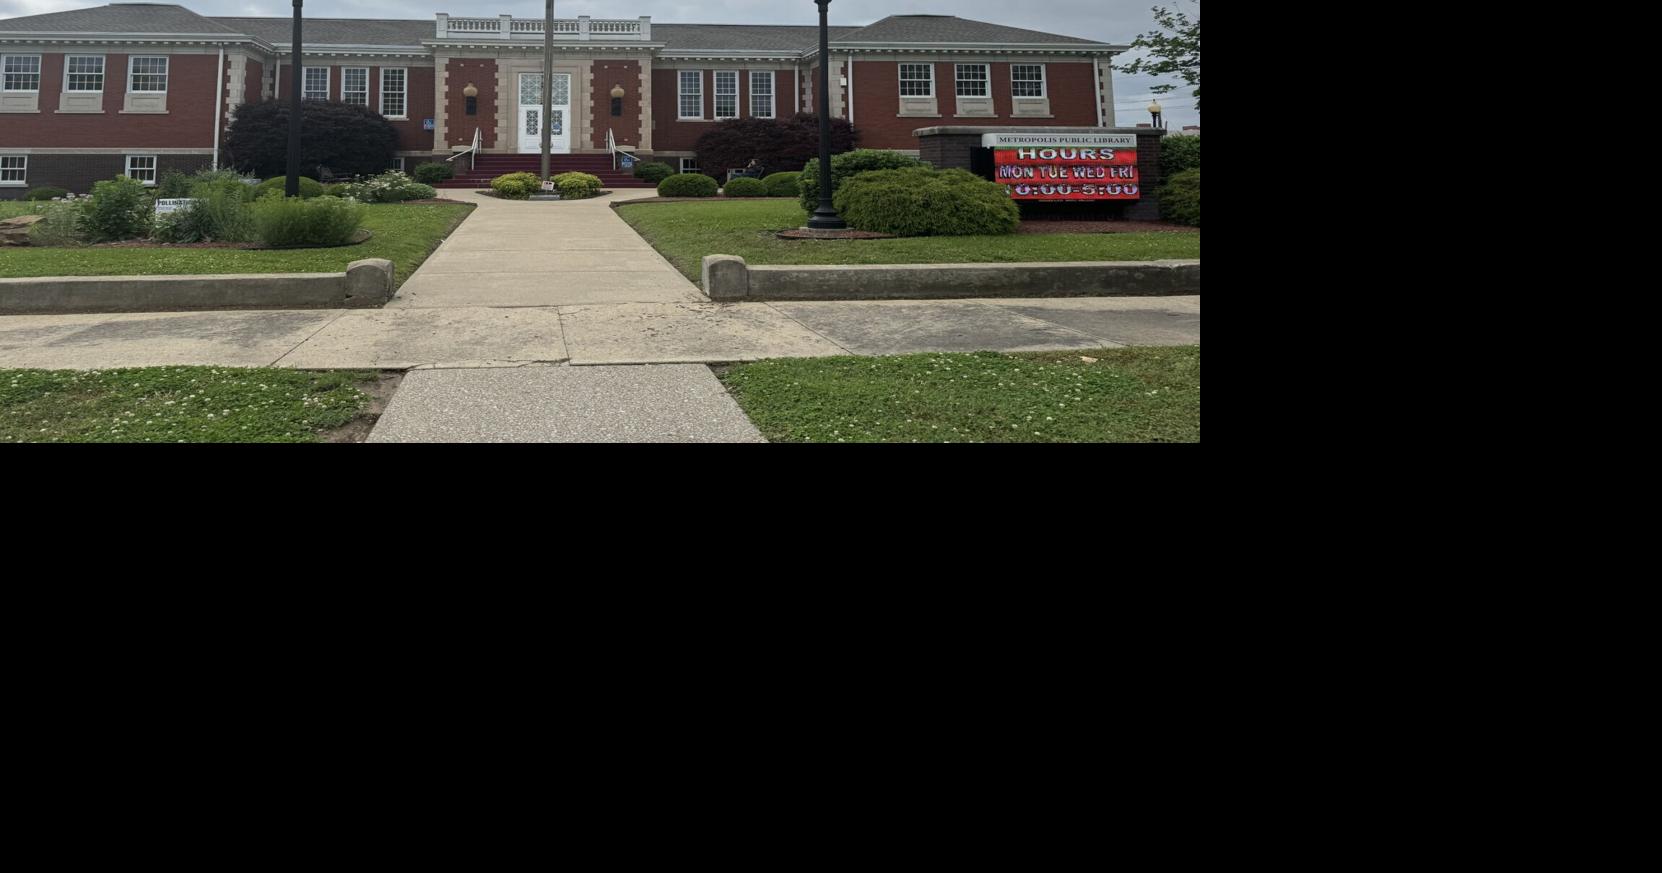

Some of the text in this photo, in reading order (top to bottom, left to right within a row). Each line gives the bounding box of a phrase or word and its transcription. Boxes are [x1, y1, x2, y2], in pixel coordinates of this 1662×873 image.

[999, 136, 1132, 144] METROPOLIS PUBLIC LIBRARY
[1018, 147, 1115, 160] HOURS
[999, 165, 1134, 178] MON TUE WED FRI
